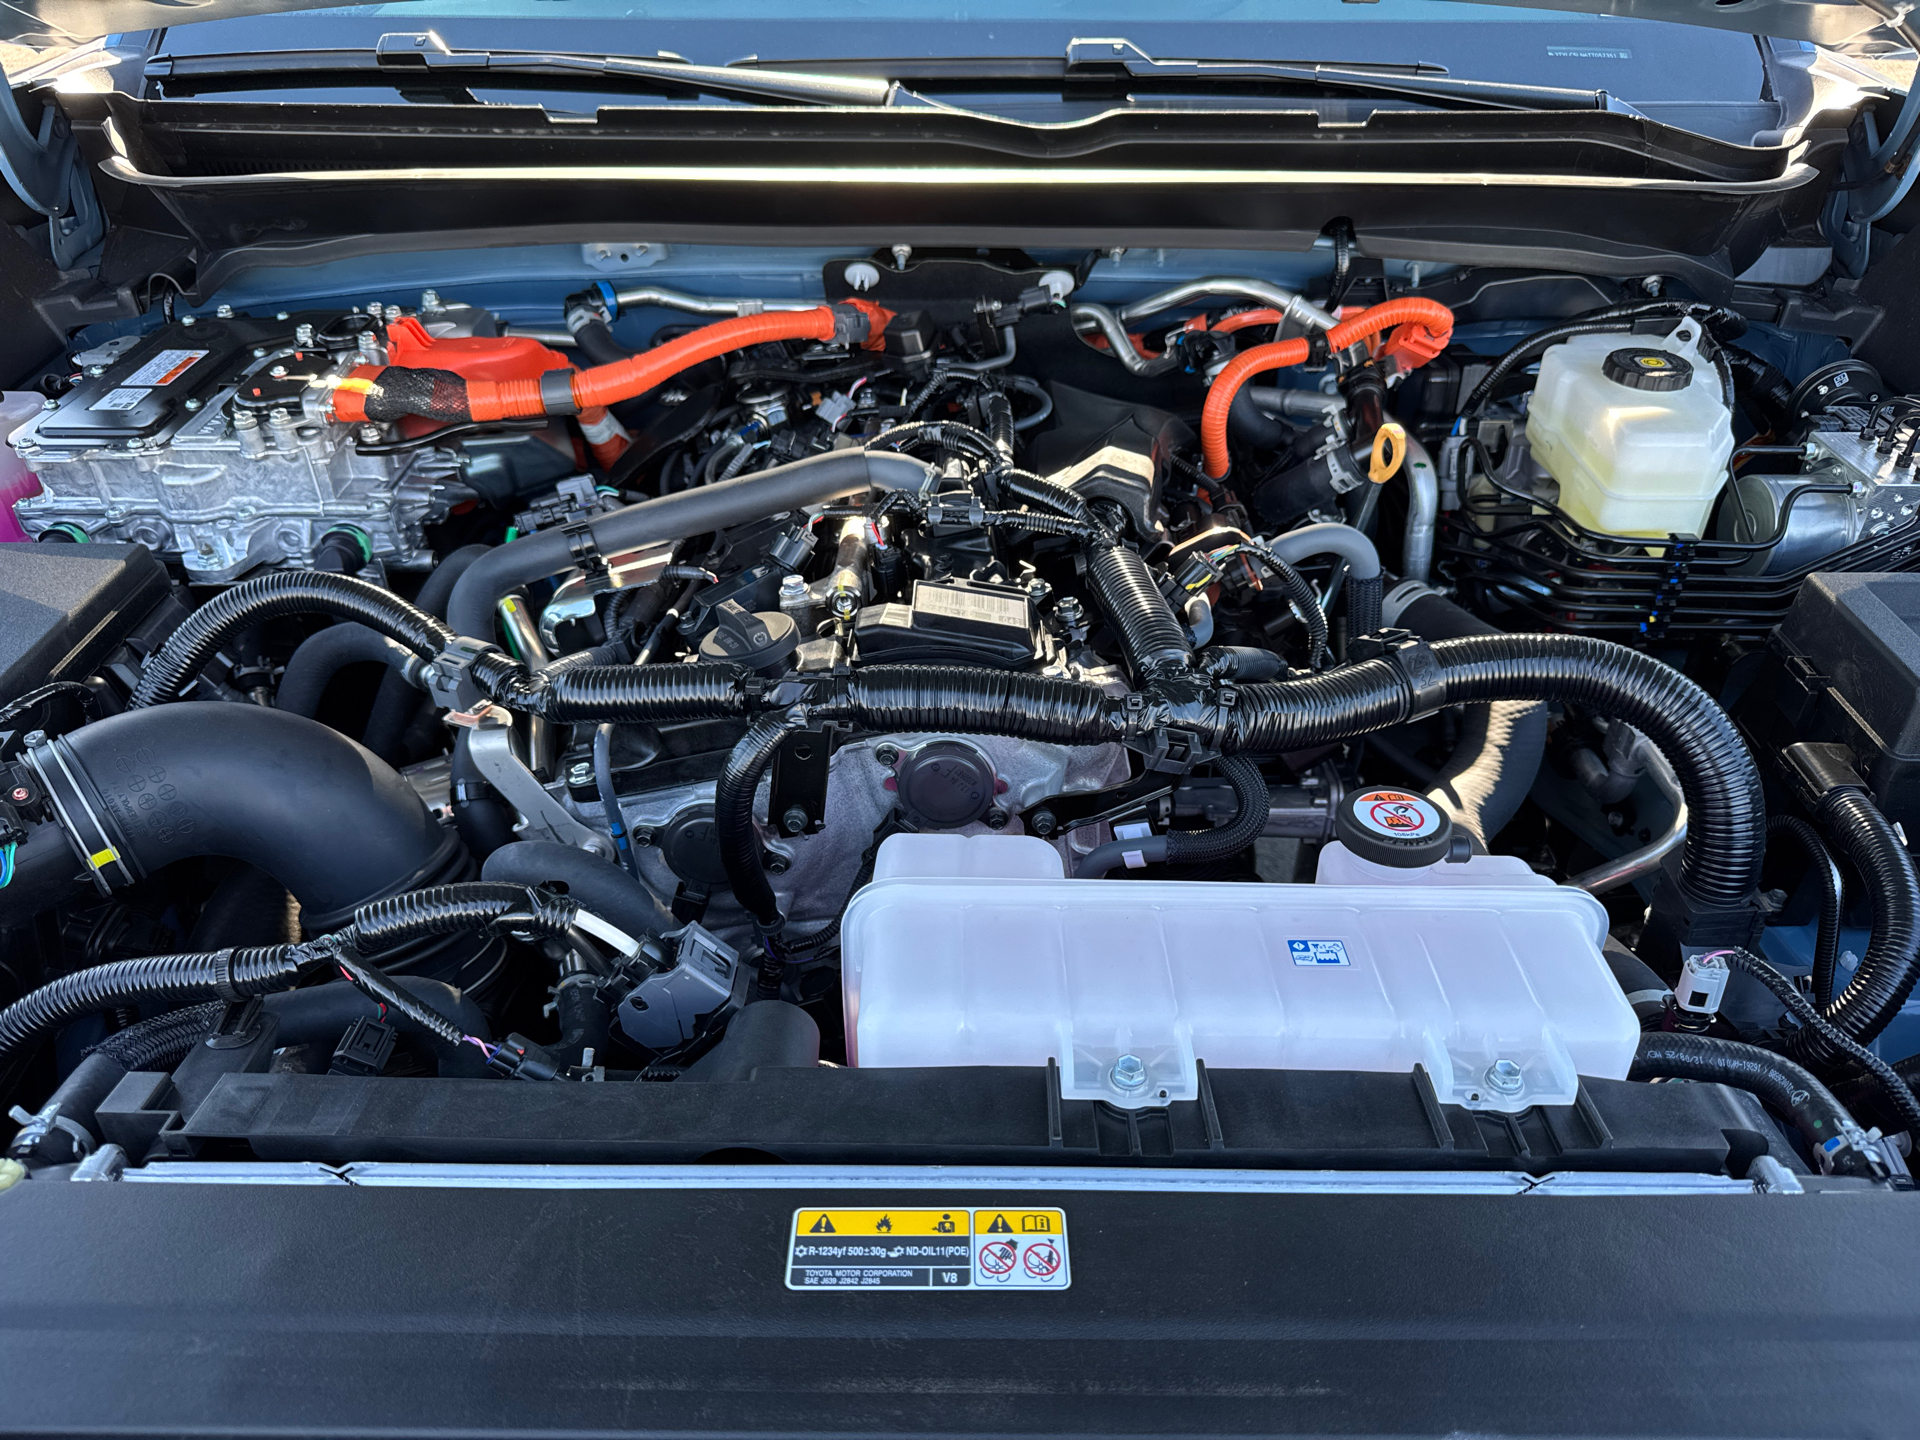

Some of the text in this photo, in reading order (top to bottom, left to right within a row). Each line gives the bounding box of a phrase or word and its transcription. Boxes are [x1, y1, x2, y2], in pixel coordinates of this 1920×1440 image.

[808, 1245, 970, 1259] R-1234yf 500±30g ND-OIL11(POE)
[805, 1269, 913, 1278] TOYOTA MOTOR CORPORATION
[942, 1271, 958, 1284] V8
[804, 1277, 881, 1285] SAE J639 J2842 J2845
